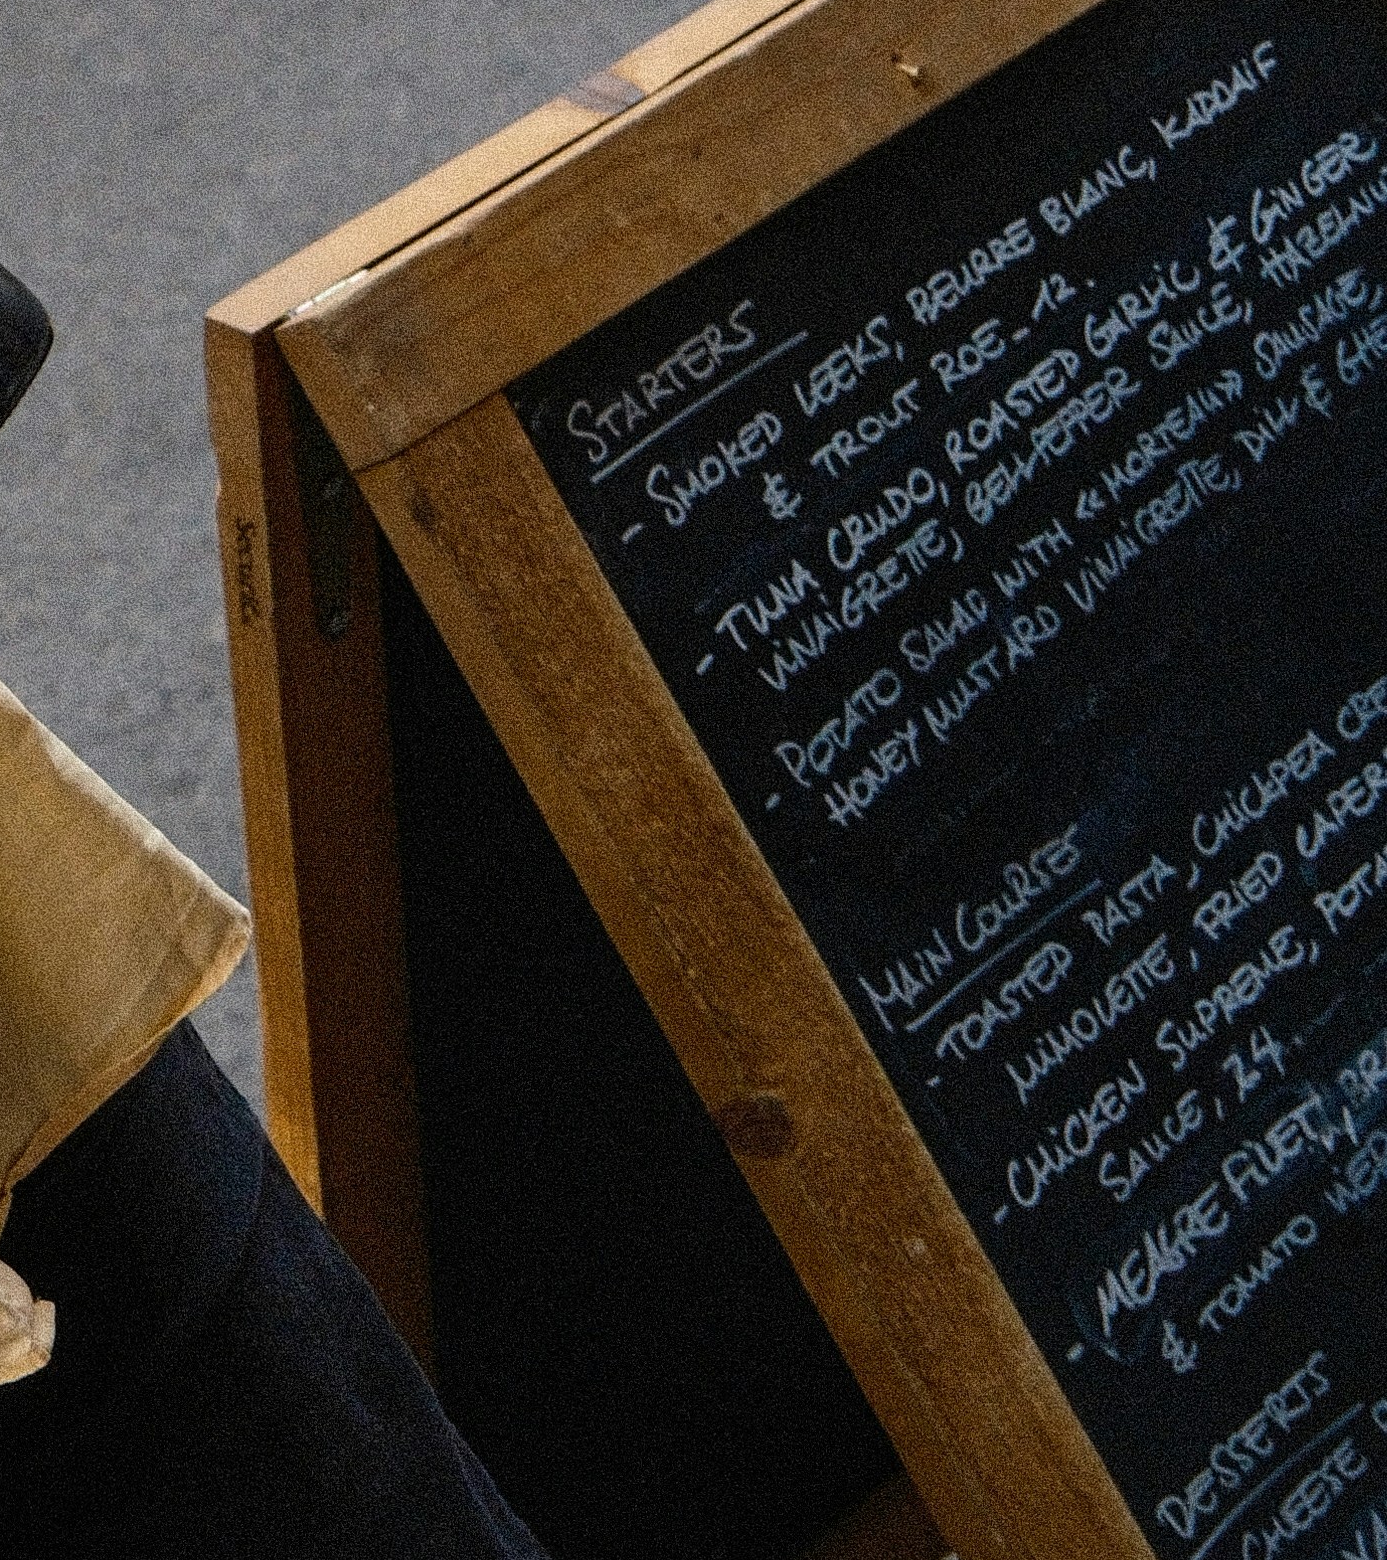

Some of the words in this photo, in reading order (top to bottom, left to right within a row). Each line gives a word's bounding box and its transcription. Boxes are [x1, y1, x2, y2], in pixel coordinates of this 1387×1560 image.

[566, 298, 757, 465] STARTERS
[645, 411, 784, 527] SMOKED
[793, 314, 905, 417] LEEKS,
[906, 217, 1036, 325] BEURRE
[1039, 145, 1158, 236] BLANC,
[1147, 281, 1254, 371] SAUCE,
[714, 559, 821, 651] TUNA
[827, 467, 950, 572] CRUDO,
[944, 349, 1081, 474] ROASTED
[1207, 214, 1247, 273] &
[762, 472, 803, 521] &
[809, 378, 920, 478] TROUT
[774, 668, 902, 788] POTATO
[899, 588, 989, 673] SALAD
[1253, 268, 1384, 380] SAUSAGE,
[824, 719, 920, 827] HONEY
[922, 605, 1062, 743] MUSTARD
[1296, 748, 1387, 860] CAPER
[935, 941, 1074, 1060] TOASTED
[1081, 854, 1201, 946] PASTA,
[955, 823, 1081, 953] COURSES
[1155, 924, 1321, 1072] SUPREME,
[1098, 1088, 1225, 1203] SAUCE,
[1097, 1182, 1230, 1337] MEAGRE
[1198, 1214, 1318, 1332] TOMATO
[1155, 1351, 1330, 1540] DESSERTS
